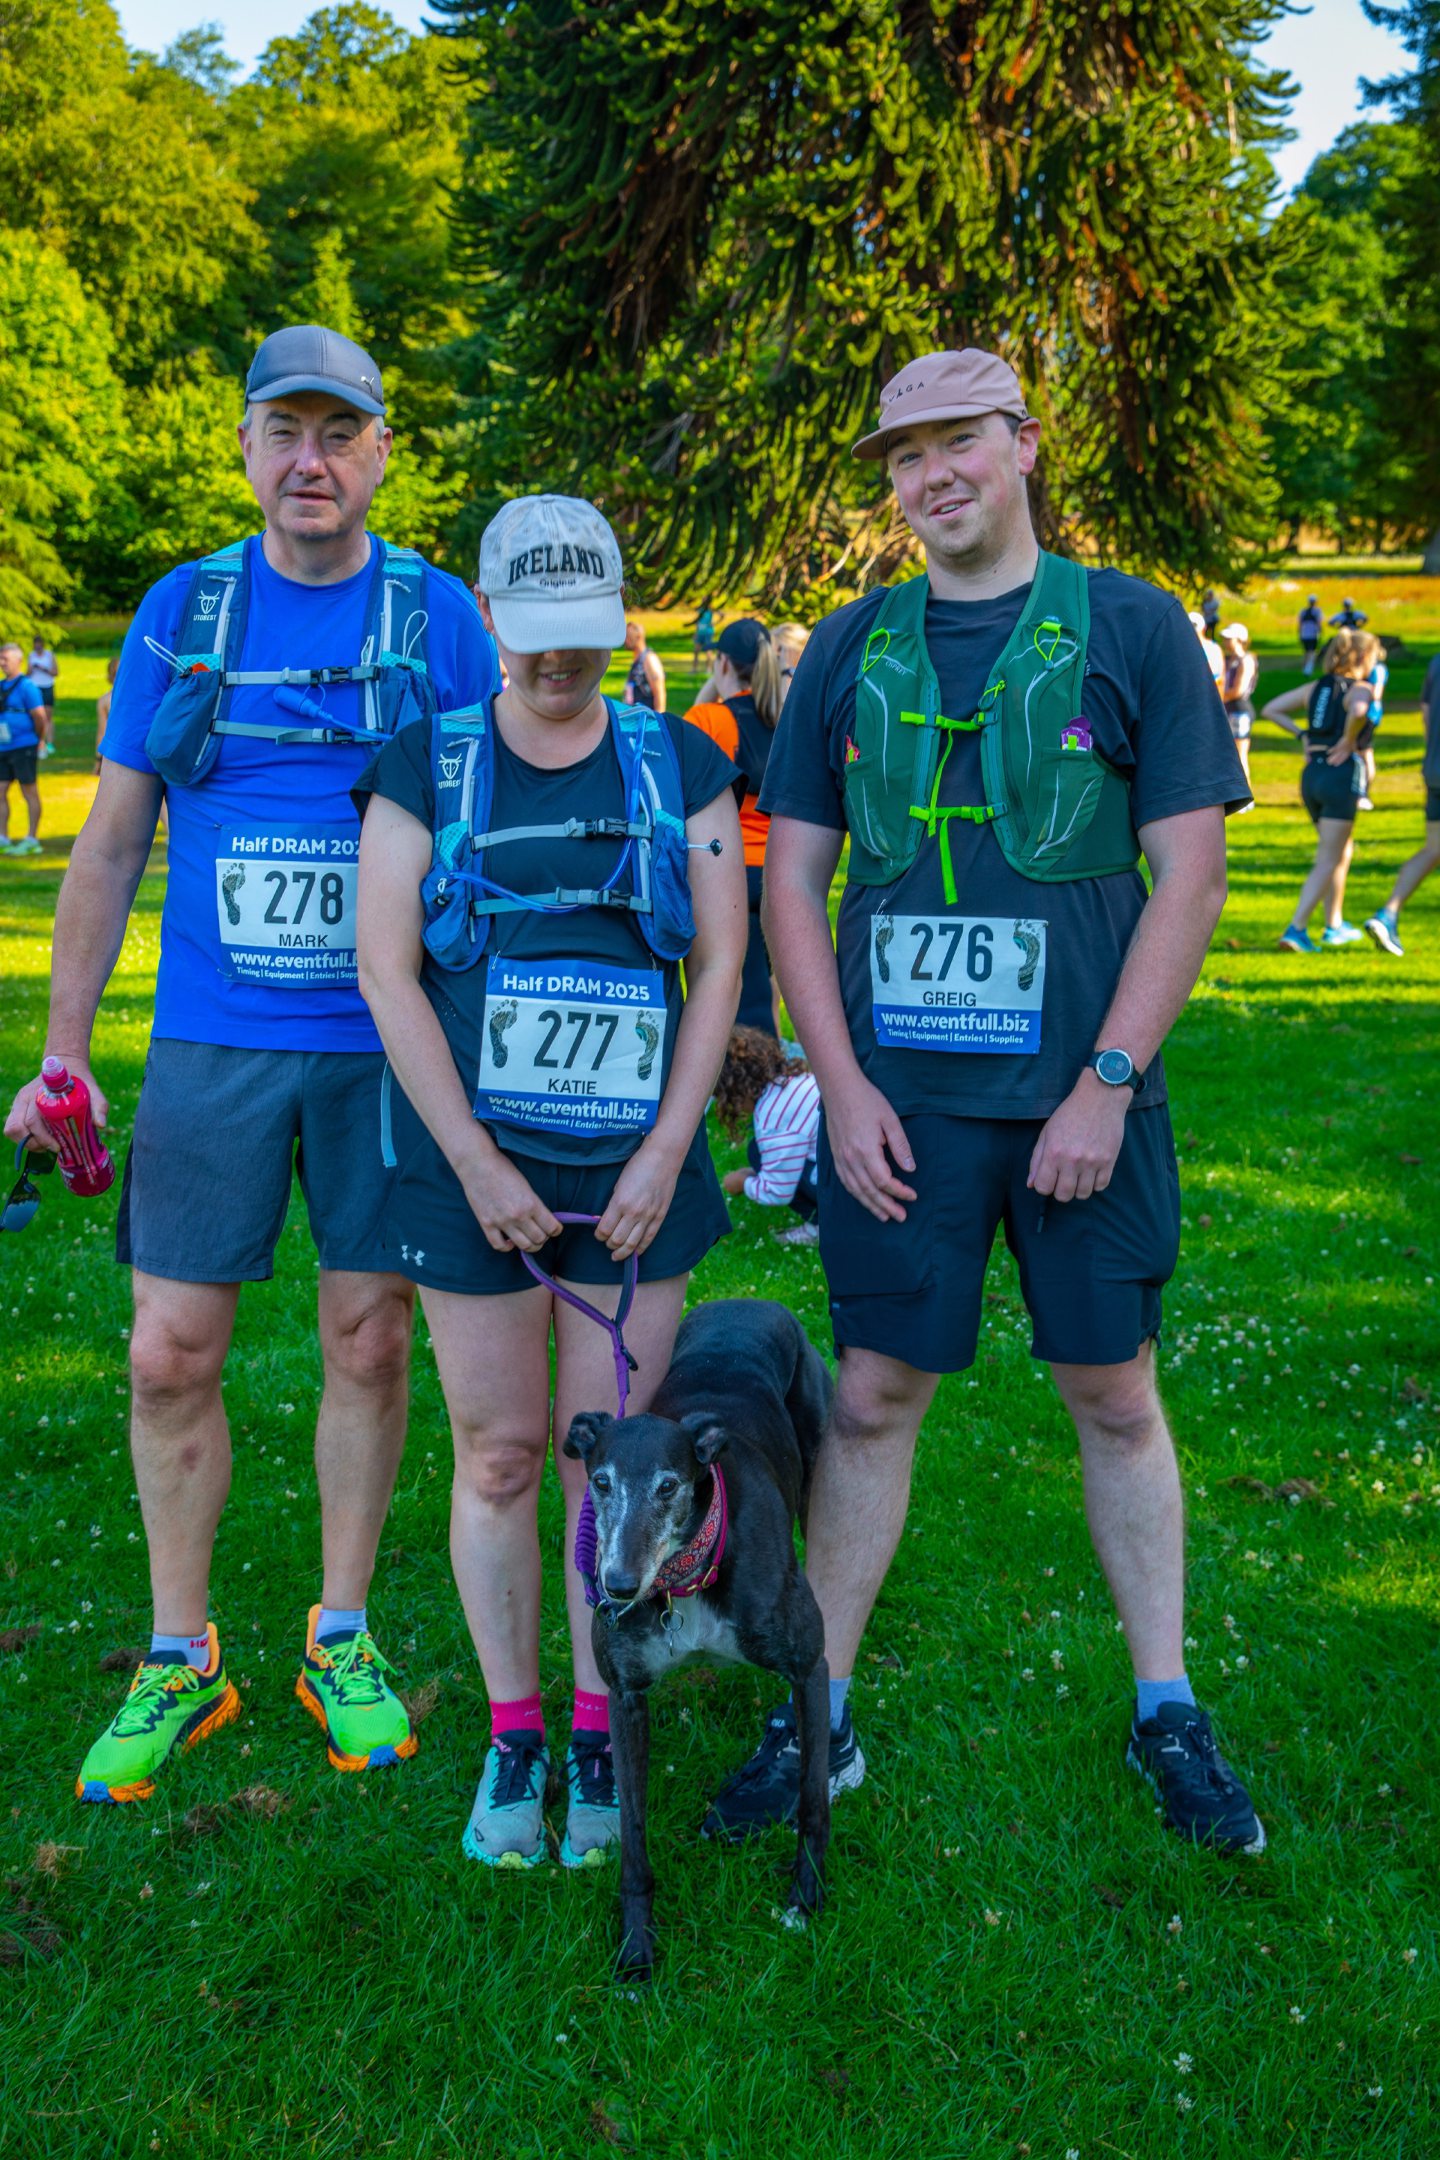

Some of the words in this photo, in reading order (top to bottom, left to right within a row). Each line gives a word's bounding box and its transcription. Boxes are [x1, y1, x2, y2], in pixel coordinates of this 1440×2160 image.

[508, 543, 605, 586] IRELAND
[232, 837, 268, 852] Half
[272, 838, 326, 854] DRAM
[264, 870, 344, 926] 278
[279, 934, 328, 948] MARK
[910, 922, 994, 982] 276
[237, 967, 260, 978] Timing
[264, 970, 304, 980] Equipment
[310, 972, 336, 980] Entries
[503, 974, 543, 992] Half
[547, 976, 600, 996] DRAM
[605, 982, 650, 1000] 2025
[922, 991, 977, 1007] GREIG
[880, 1012, 1030, 1032] www.eventfull.biz
[534, 1010, 620, 1072] 277
[888, 1028, 908, 1039] Timing
[912, 1031, 948, 1042] Equipment
[954, 1034, 983, 1042] Entries
[989, 1034, 1024, 1044] Supplies
[547, 1078, 598, 1096] KATIE
[488, 1096, 648, 1121] www.eventfull.biz
[491, 1105, 519, 1118] Timing
[525, 1114, 570, 1128] Equipment
[574, 1120, 602, 1130] Entries
[606, 1121, 639, 1131] Supplies
